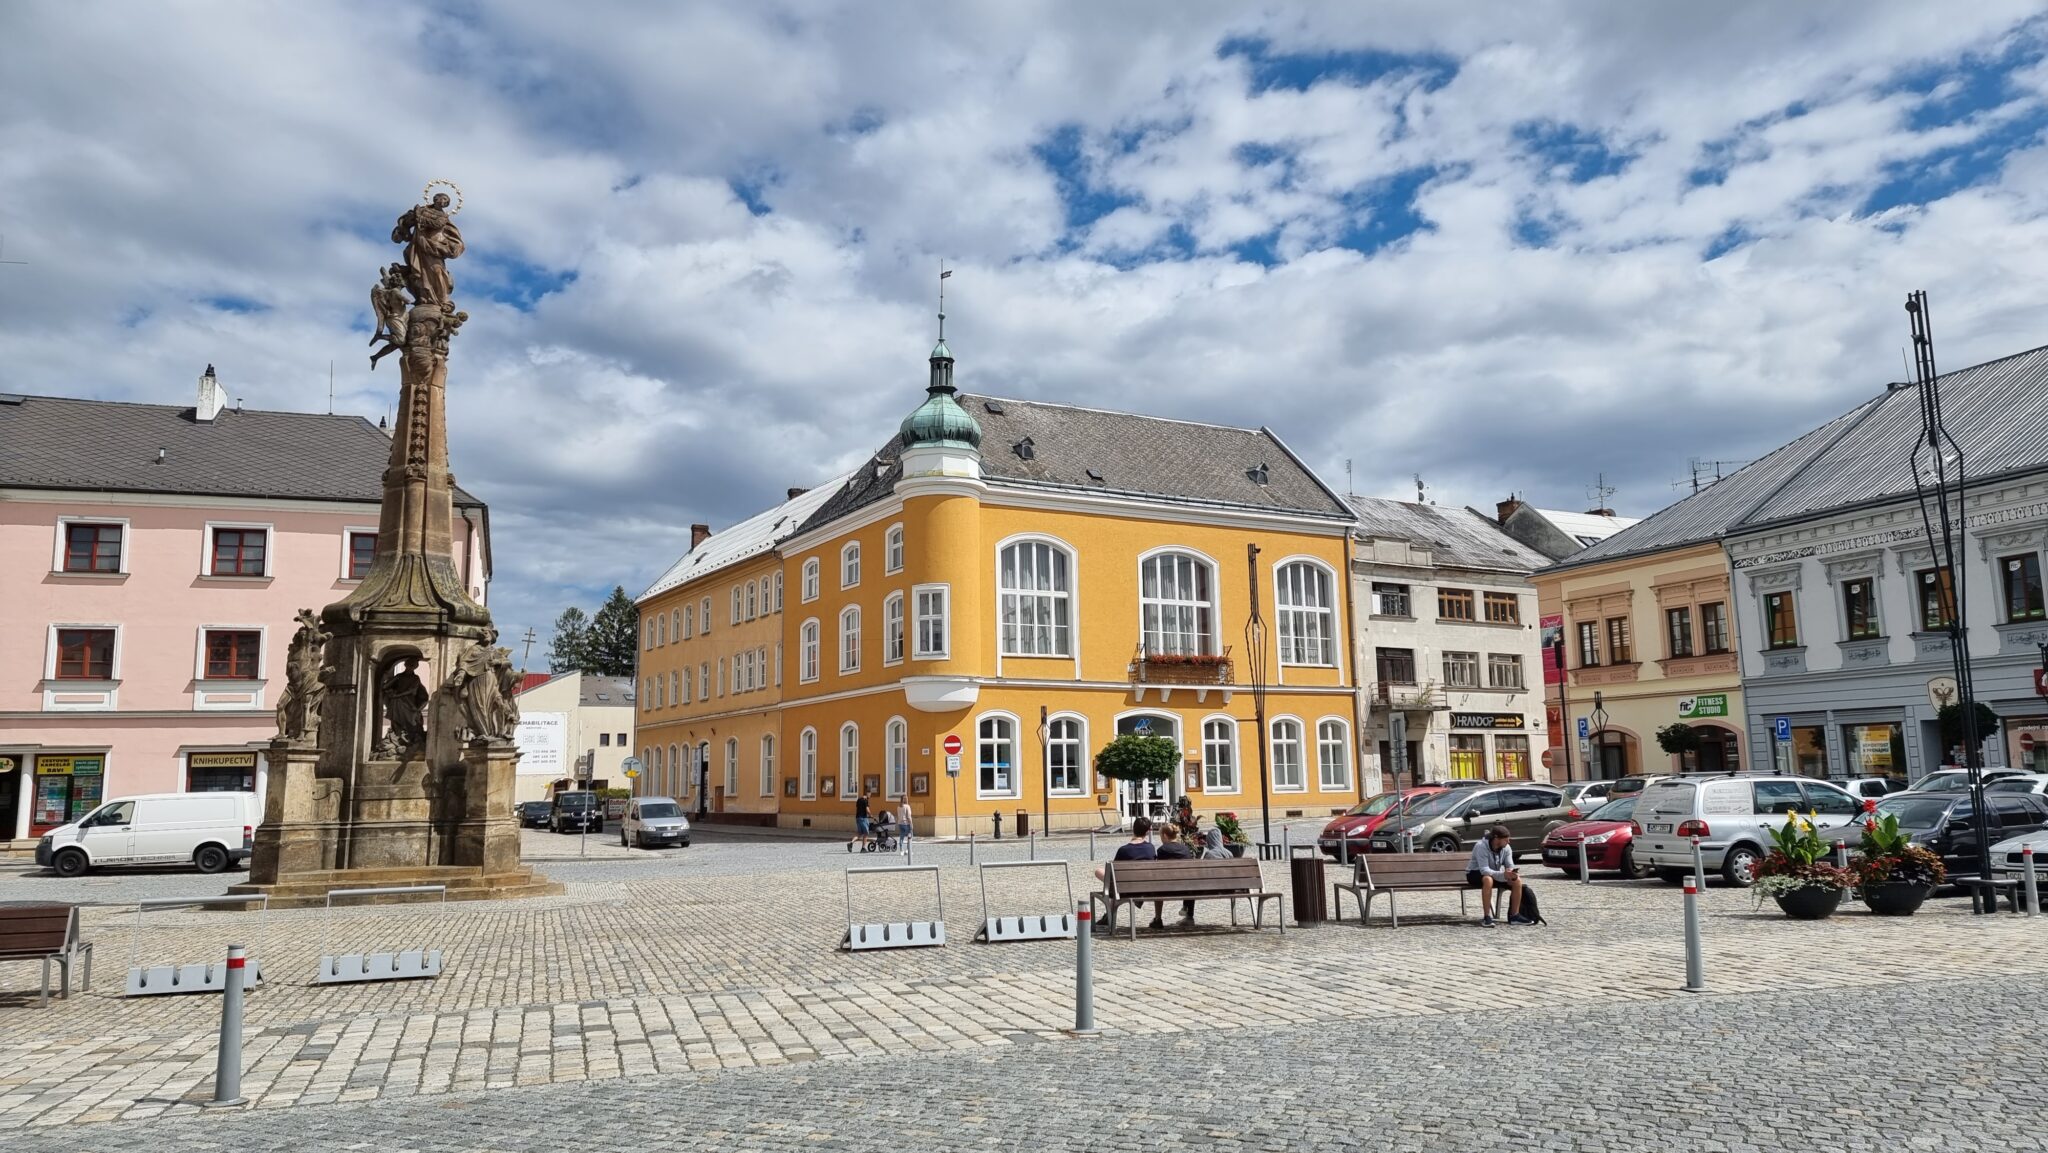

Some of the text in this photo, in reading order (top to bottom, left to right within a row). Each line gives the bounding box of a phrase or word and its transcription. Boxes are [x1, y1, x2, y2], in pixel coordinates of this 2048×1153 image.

[1698, 697, 1724, 706] FITNESS
[1699, 706, 1721, 714] STUDIO
[1778, 719, 1787, 734] P
[193, 755, 252, 765] KNIHKUPECTVÍ
